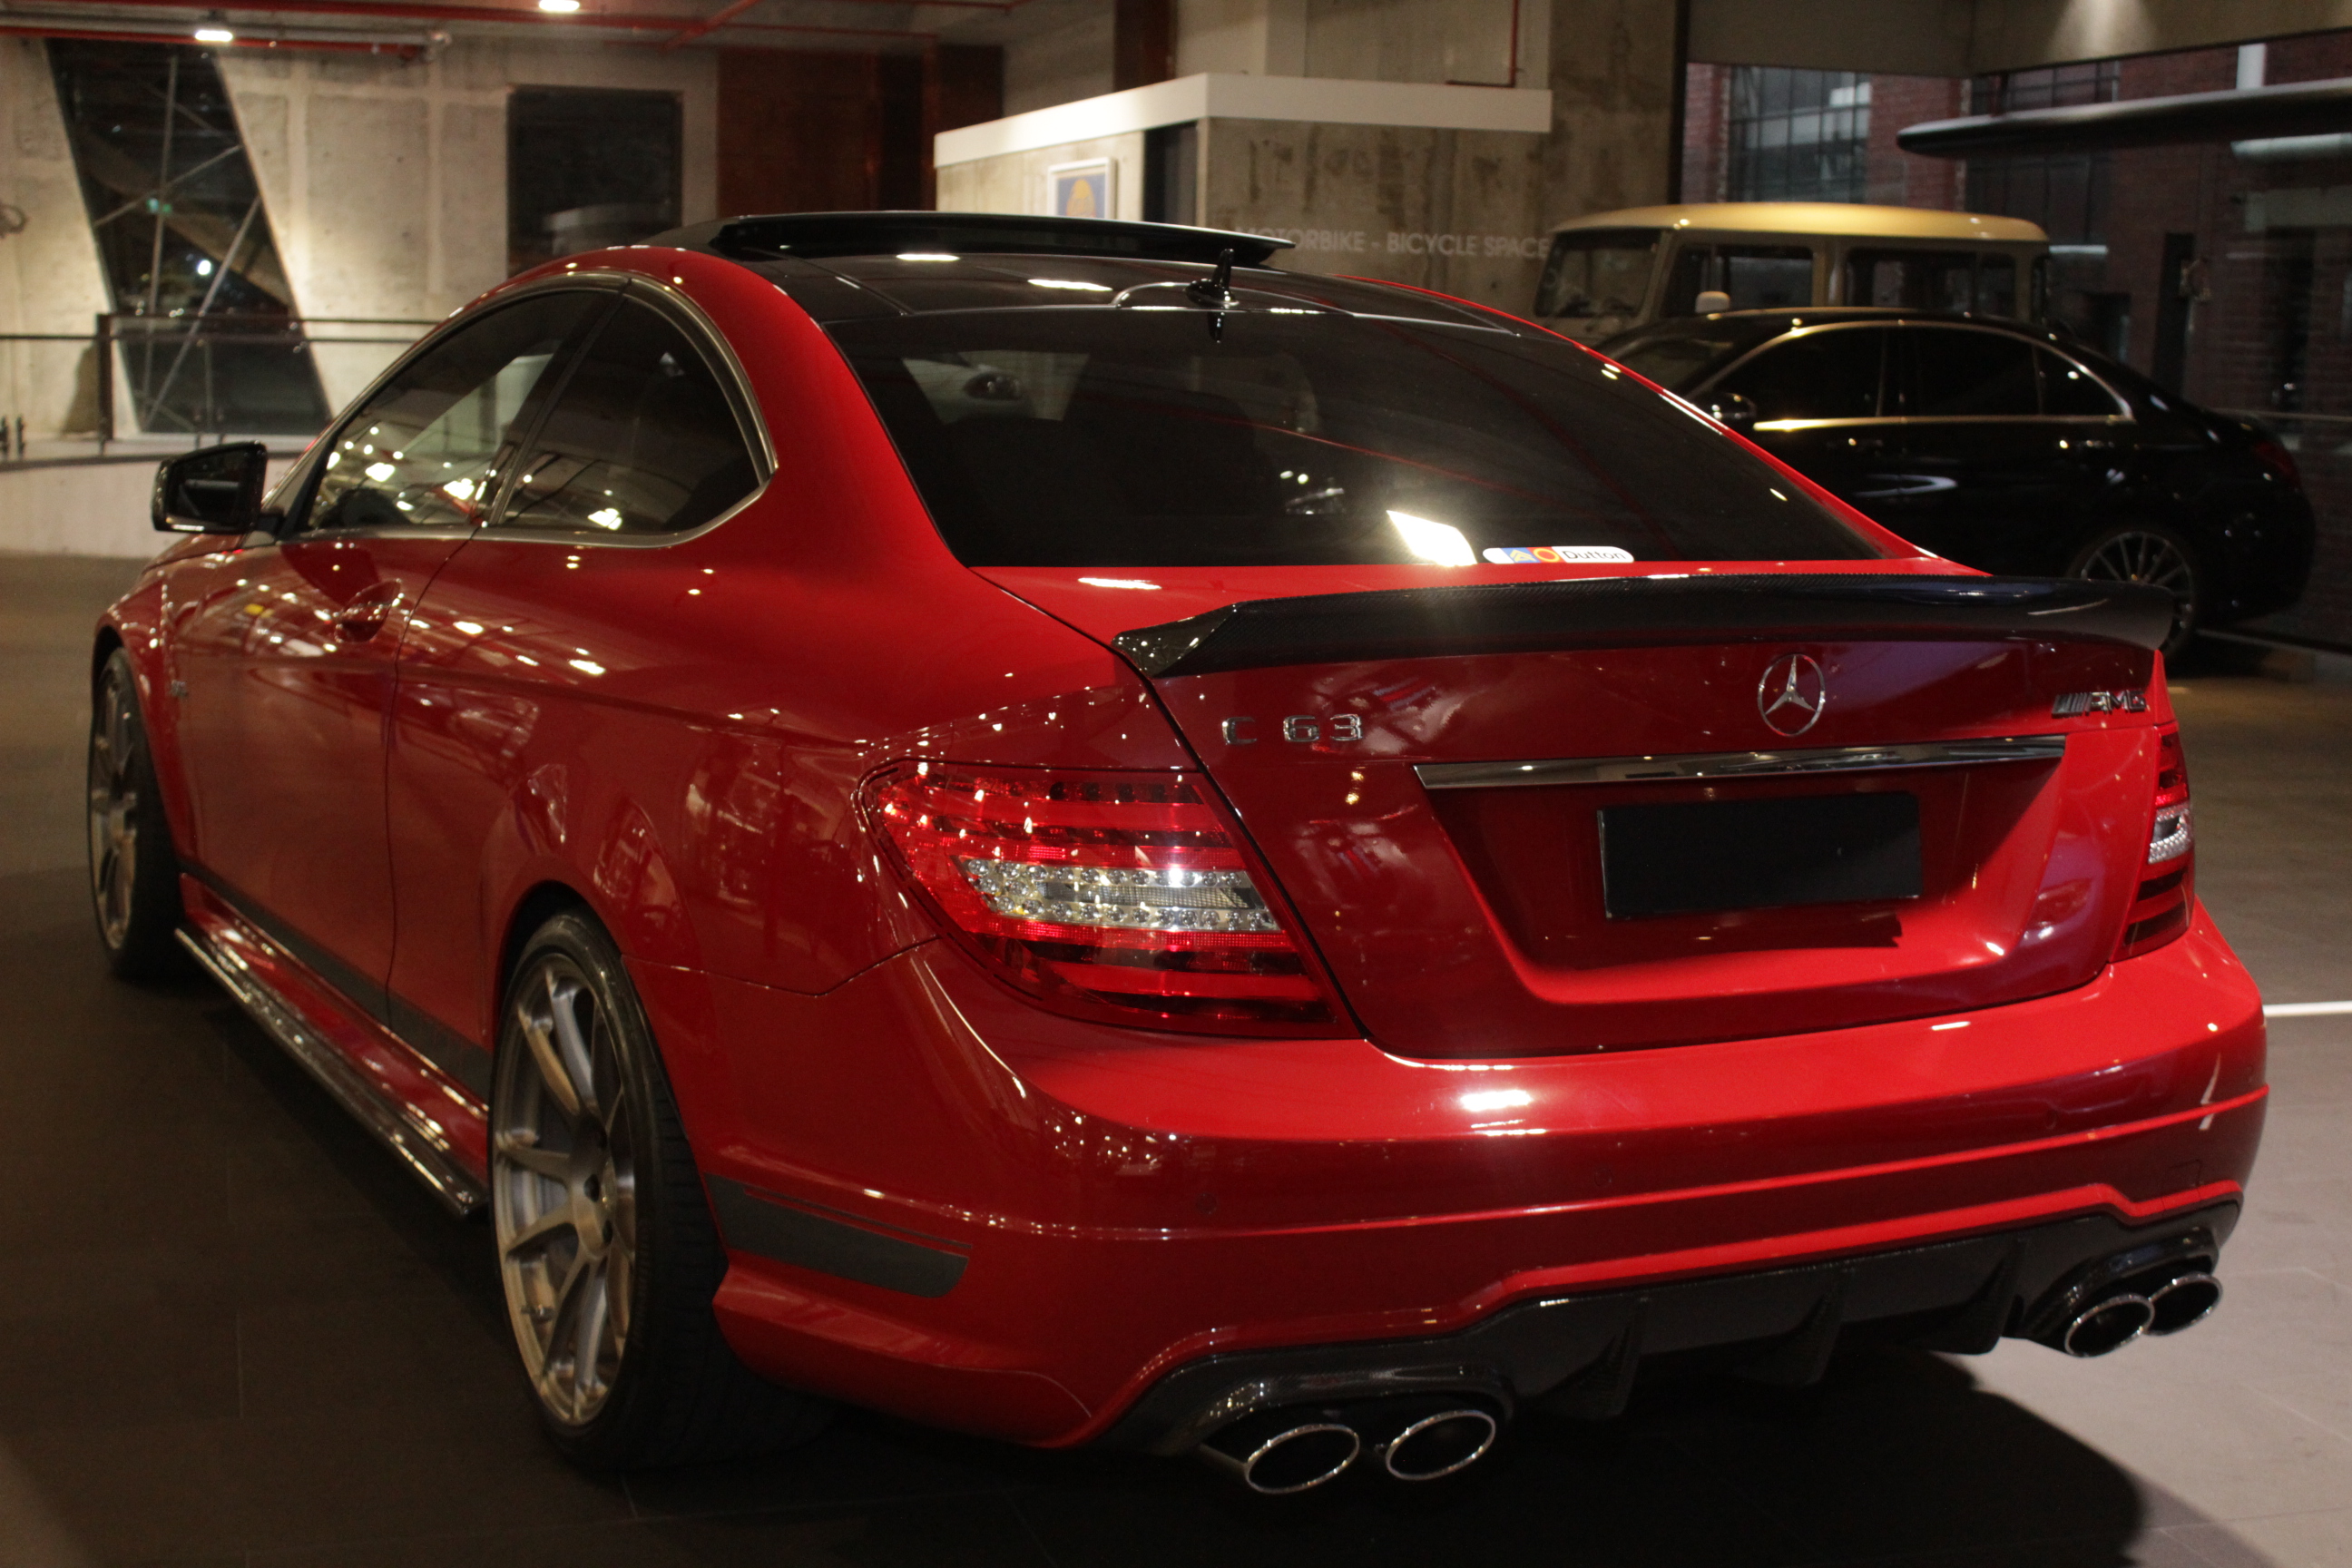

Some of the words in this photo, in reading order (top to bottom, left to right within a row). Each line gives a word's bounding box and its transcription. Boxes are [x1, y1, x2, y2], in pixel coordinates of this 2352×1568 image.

[1387, 231, 1477, 256] BICYCLE
[1484, 236, 1550, 259] SPACE
[1562, 549, 1627, 561] Dutton
[2084, 689, 2147, 715] AMG
[1221, 716, 1258, 745] C
[1282, 713, 1363, 742] 63
